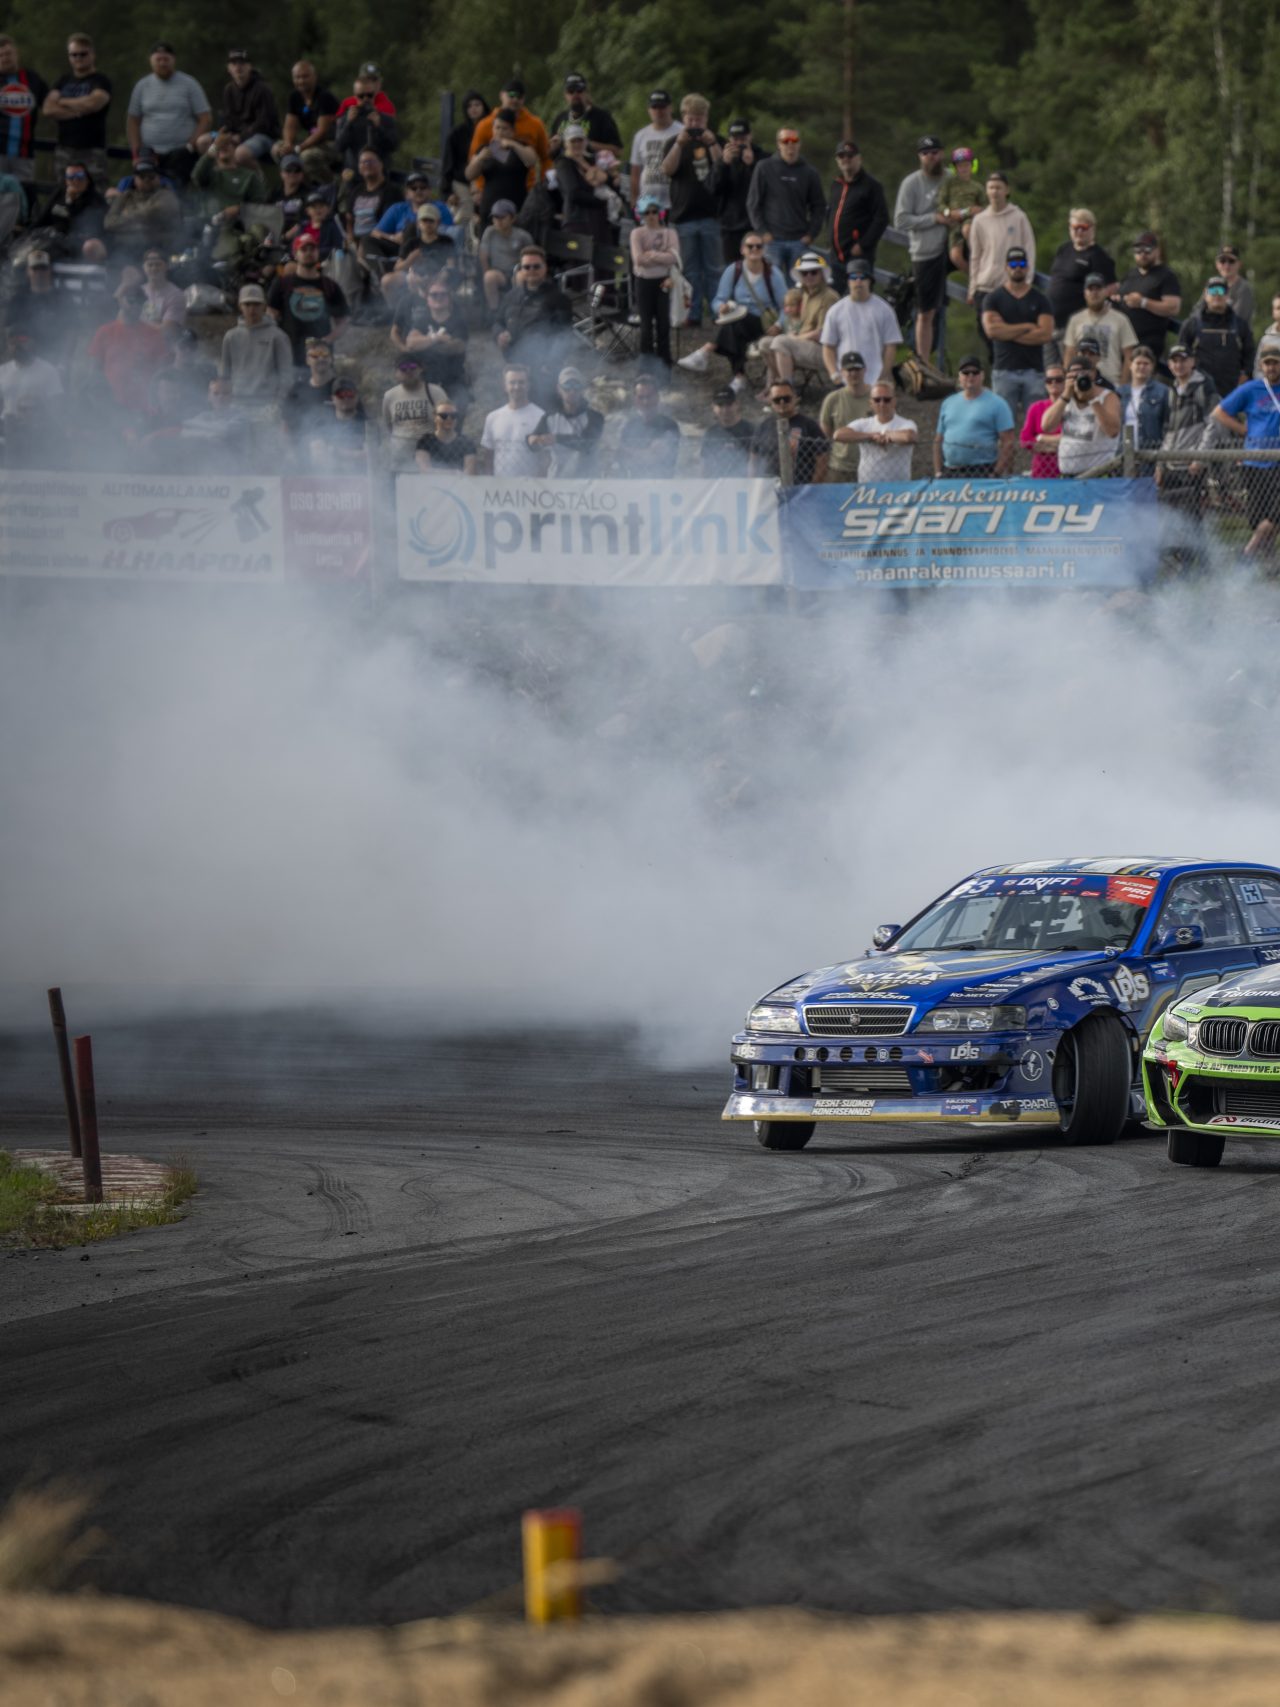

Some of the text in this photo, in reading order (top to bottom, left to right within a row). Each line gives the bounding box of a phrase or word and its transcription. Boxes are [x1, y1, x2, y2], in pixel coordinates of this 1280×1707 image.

[101, 482, 230, 499] AUTOMAALAAMO
[483, 489, 617, 511] MAINOSTALO
[839, 483, 1047, 511] Maanrakennus
[483, 492, 774, 569] printlink
[855, 561, 1076, 582] maanrakennussaari.fi
[950, 879, 993, 898] 63
[1017, 877, 1077, 891] DRIFT
[1120, 886, 1152, 896] PRO
[814, 1100, 876, 1108] KESKI-SUOMEN
